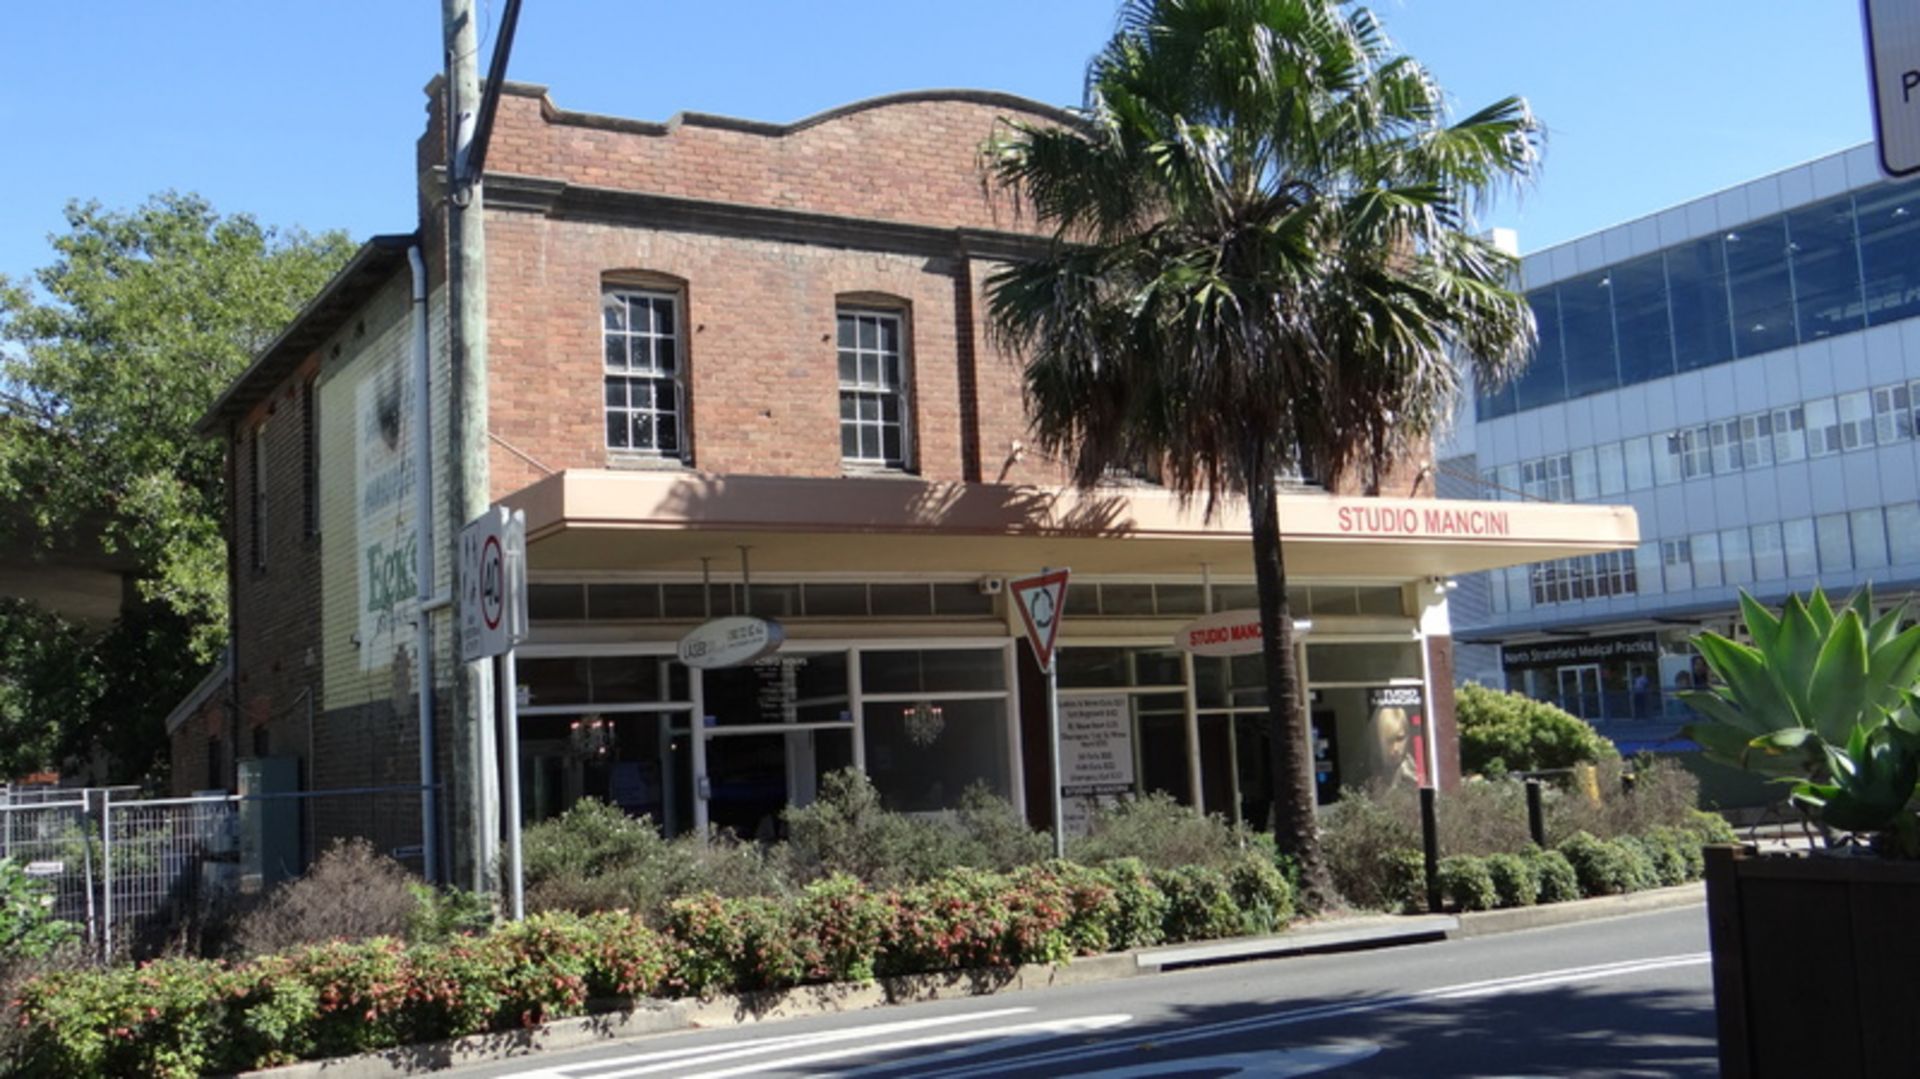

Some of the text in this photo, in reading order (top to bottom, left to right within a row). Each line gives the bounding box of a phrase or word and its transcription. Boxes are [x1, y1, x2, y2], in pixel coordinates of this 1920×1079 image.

[1338, 506, 1510, 535] STUDIO MANCINI
[483, 557, 500, 607] 40
[1189, 626, 1229, 647] STUDIO
[1504, 651, 1530, 664] North
[1579, 643, 1613, 656] Medical
[1615, 640, 1654, 653] Practice
